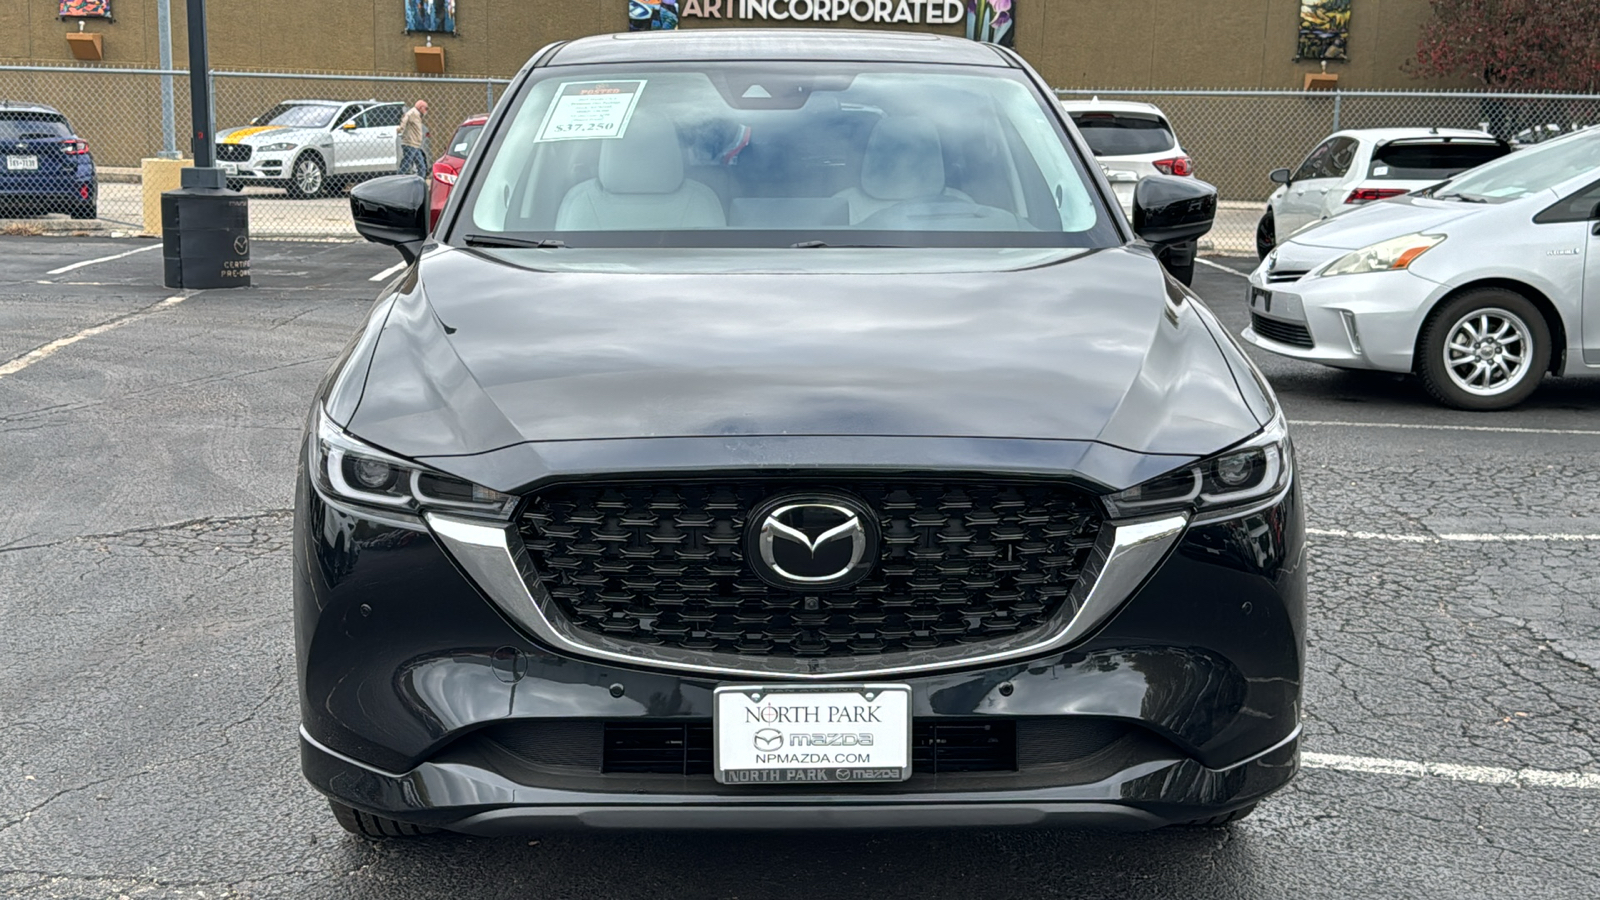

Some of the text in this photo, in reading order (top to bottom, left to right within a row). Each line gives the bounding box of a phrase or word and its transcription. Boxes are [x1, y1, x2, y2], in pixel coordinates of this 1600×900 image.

[745, 705, 882, 724] NORTH PARK
[789, 732, 874, 747] mazda
[755, 753, 870, 764] NPMAZDA.COM
[728, 769, 900, 782] NORTH PARK mazda
